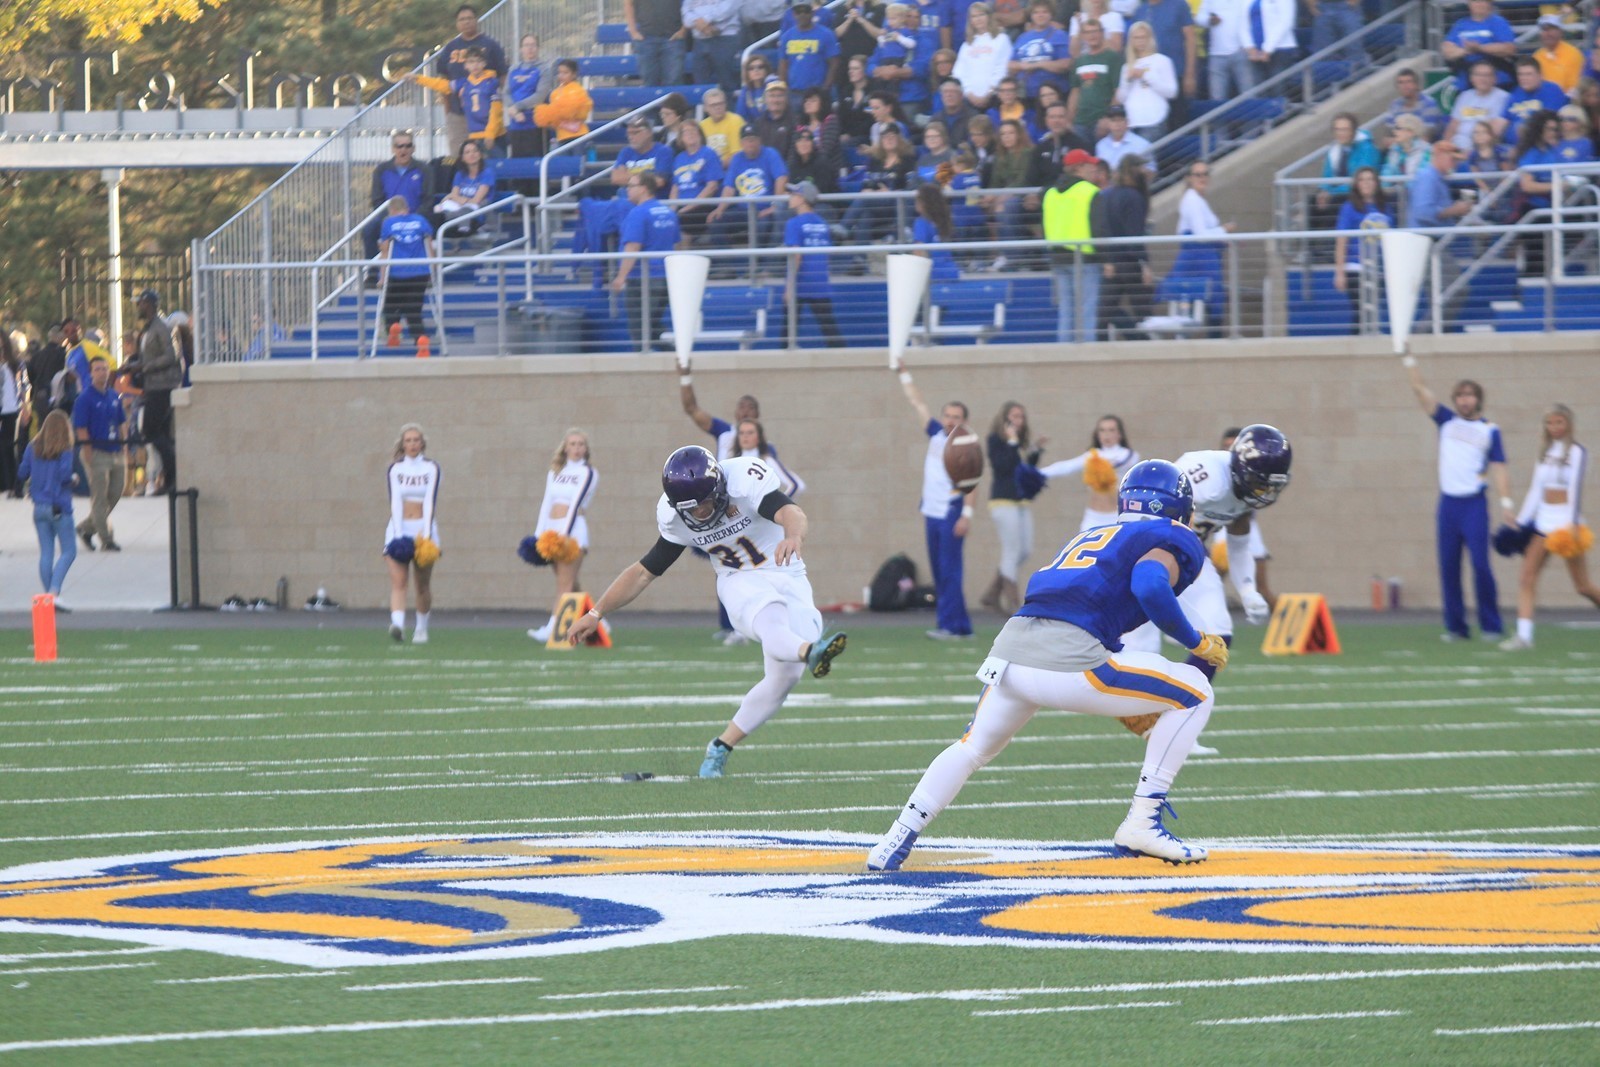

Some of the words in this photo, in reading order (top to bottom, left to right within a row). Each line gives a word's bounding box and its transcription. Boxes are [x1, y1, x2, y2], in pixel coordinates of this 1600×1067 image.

[397, 473, 430, 486] STATE
[747, 462, 767, 480] 31
[1188, 463, 1209, 485] 39
[692, 516, 752, 546] LEATHERNECKS
[554, 599, 576, 642] G
[1272, 600, 1308, 647] 10
